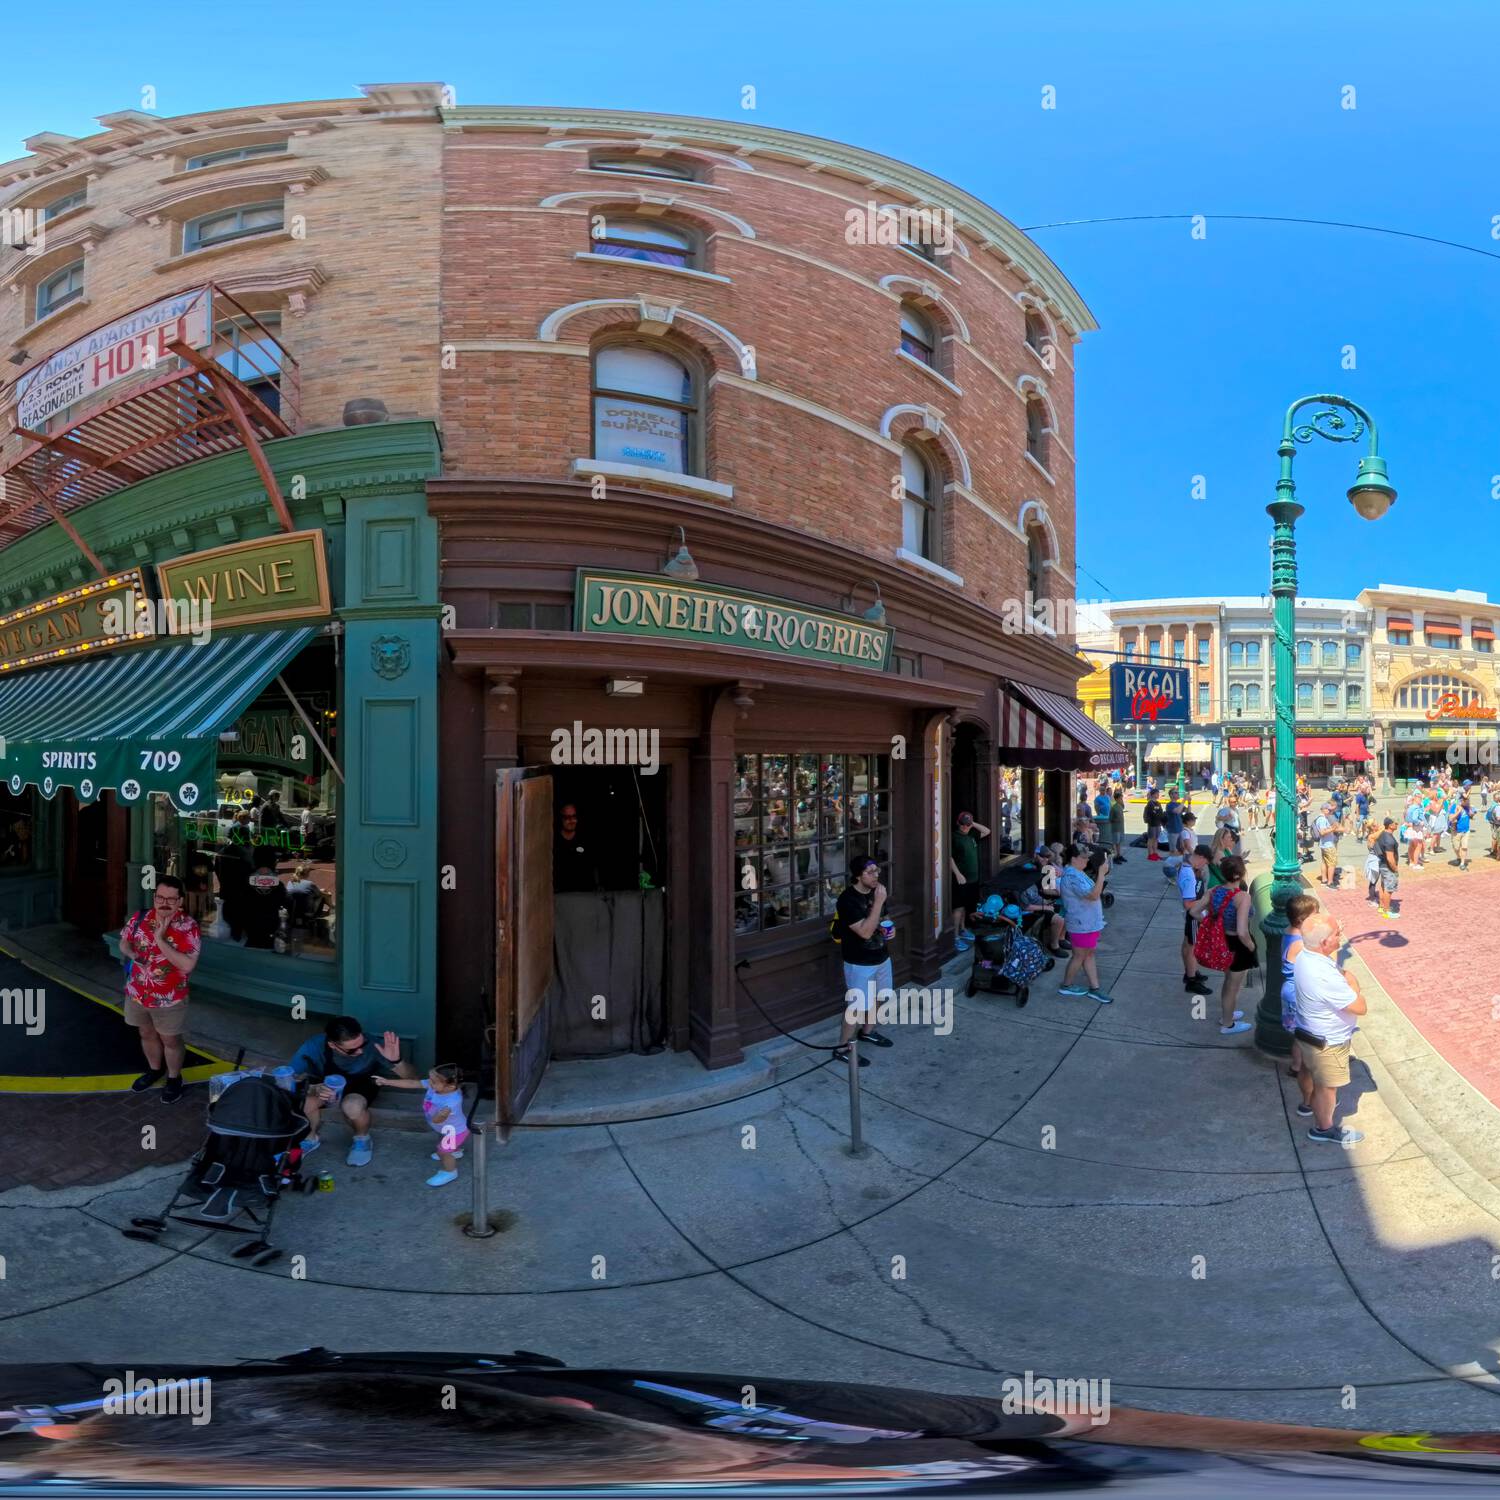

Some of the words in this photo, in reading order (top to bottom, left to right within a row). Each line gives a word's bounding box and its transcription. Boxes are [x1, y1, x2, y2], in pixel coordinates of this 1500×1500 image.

[92, 318, 198, 387] HOTEL
[46, 363, 85, 391] ROOM
[21, 381, 84, 428] REASONABLE
[183, 559, 296, 605] WINE
[592, 586, 738, 635] JONEH'S
[741, 605, 884, 662] GROCERIES
[1125, 668, 1184, 700] REGAL
[42, 751, 97, 769] SPIRITS
[139, 750, 182, 772] 709
[223, 786, 255, 805] 709
